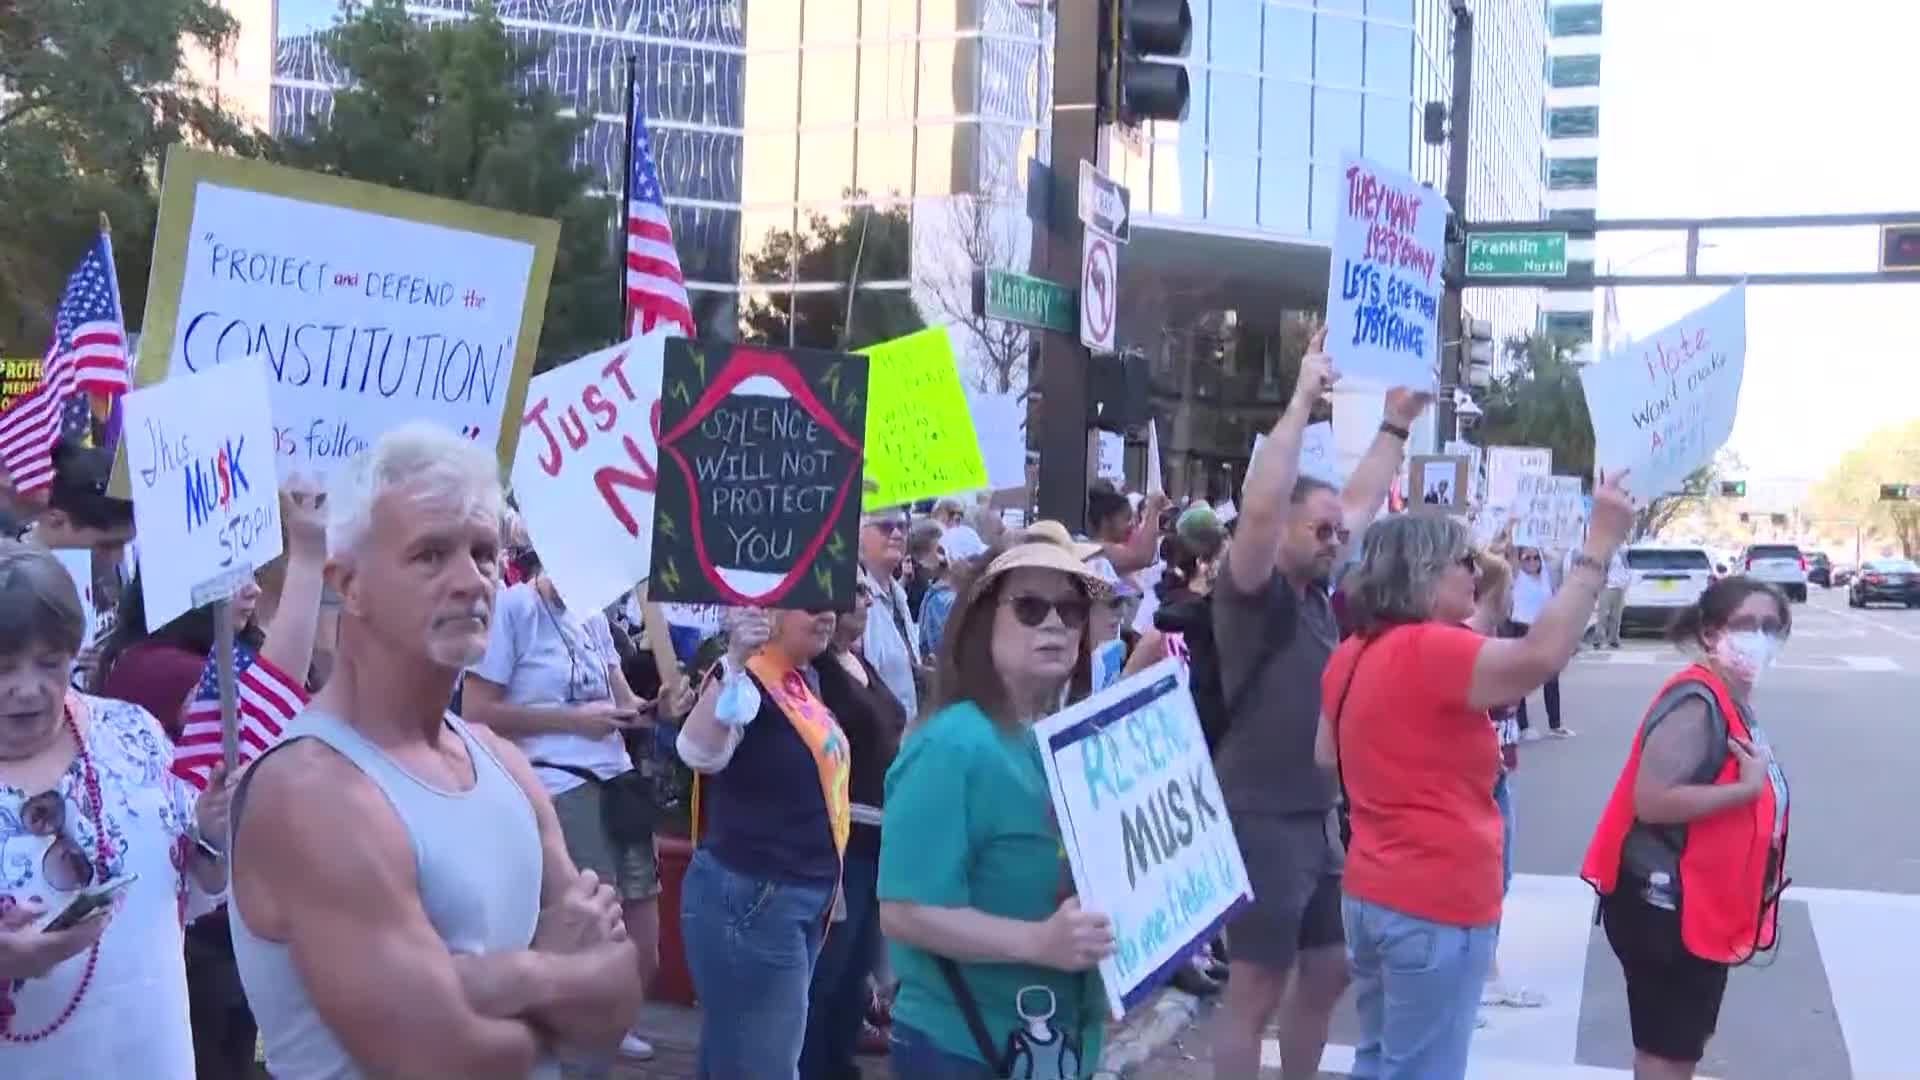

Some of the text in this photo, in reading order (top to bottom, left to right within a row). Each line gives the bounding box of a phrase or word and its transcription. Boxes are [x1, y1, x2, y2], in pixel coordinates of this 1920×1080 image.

[1346, 165, 1422, 233] THEY WANT
[1471, 239, 1539, 256] Franklin
[333, 272, 359, 288] and
[365, 272, 455, 306] DEFEND
[997, 273, 1051, 322] Kennedy
[522, 348, 637, 477] JUST
[695, 446, 834, 481] WILL NOT
[712, 485, 835, 516] PROTECT
[727, 523, 793, 566] YOU
[1120, 772, 1219, 891] MUSK
